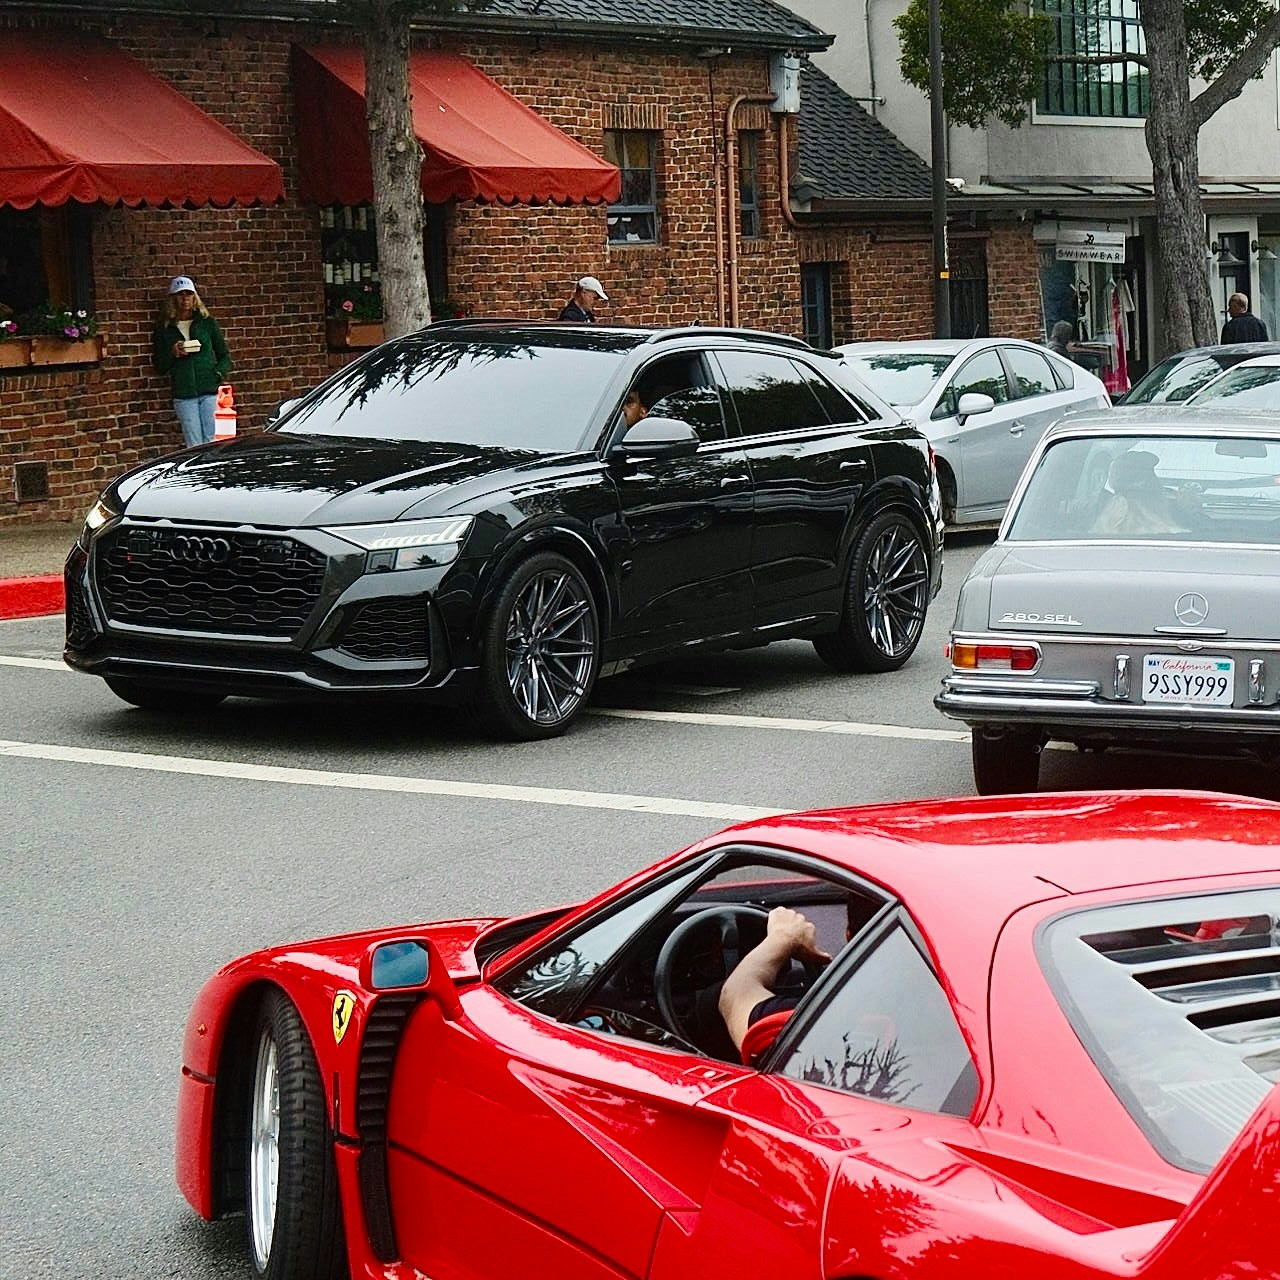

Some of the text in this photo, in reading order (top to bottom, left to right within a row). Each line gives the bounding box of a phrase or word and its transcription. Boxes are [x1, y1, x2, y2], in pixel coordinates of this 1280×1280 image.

[1057, 249, 1121, 260] SWIMWEAR
[1002, 612, 1040, 621] 280
[1162, 659, 1213, 673] California
[1148, 673, 1228, 697] 9SSY999
